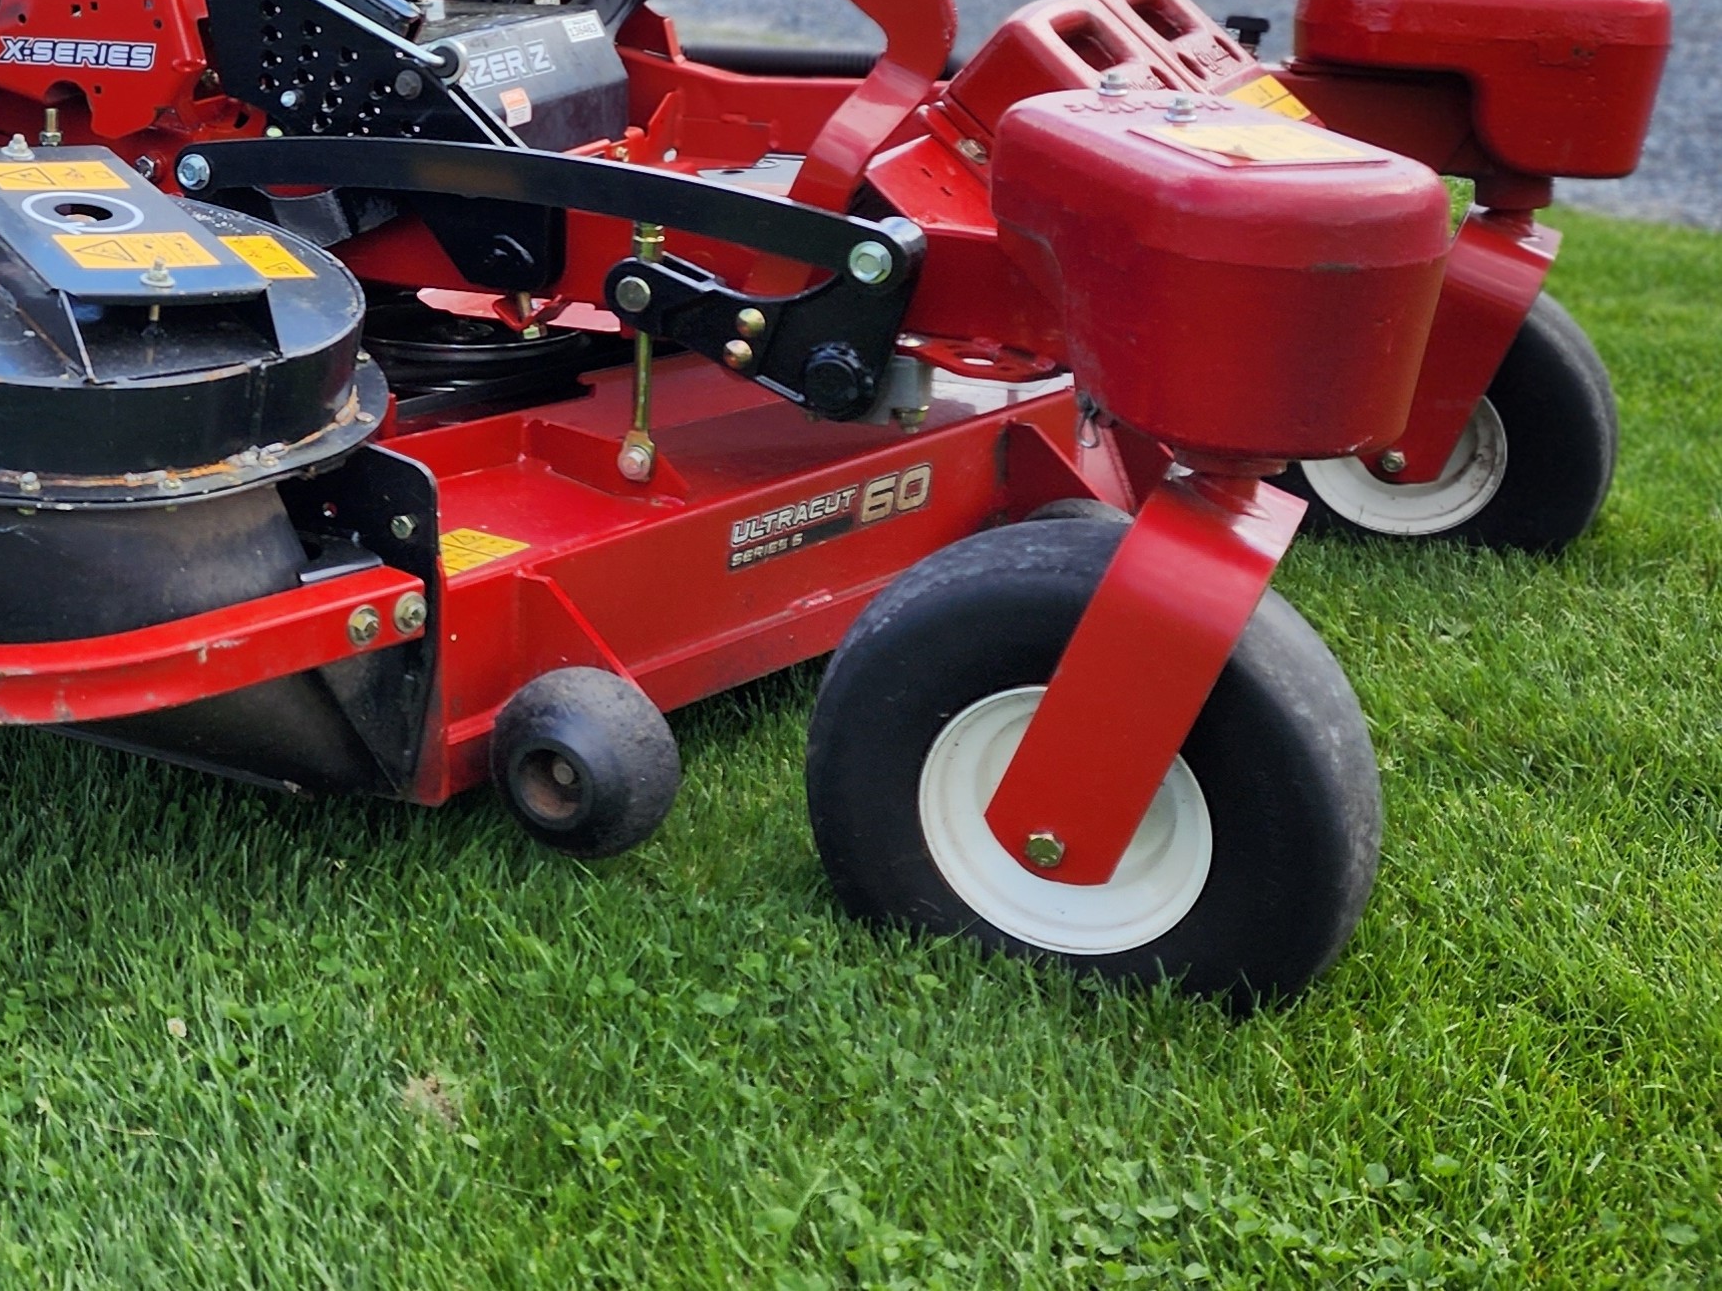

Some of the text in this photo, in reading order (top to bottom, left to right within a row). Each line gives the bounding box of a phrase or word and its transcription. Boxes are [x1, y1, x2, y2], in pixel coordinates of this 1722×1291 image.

[461, 42, 553, 87] AZER Z
[731, 462, 933, 546] ULTRACUT 60
[730, 539, 789, 567] SERIES
